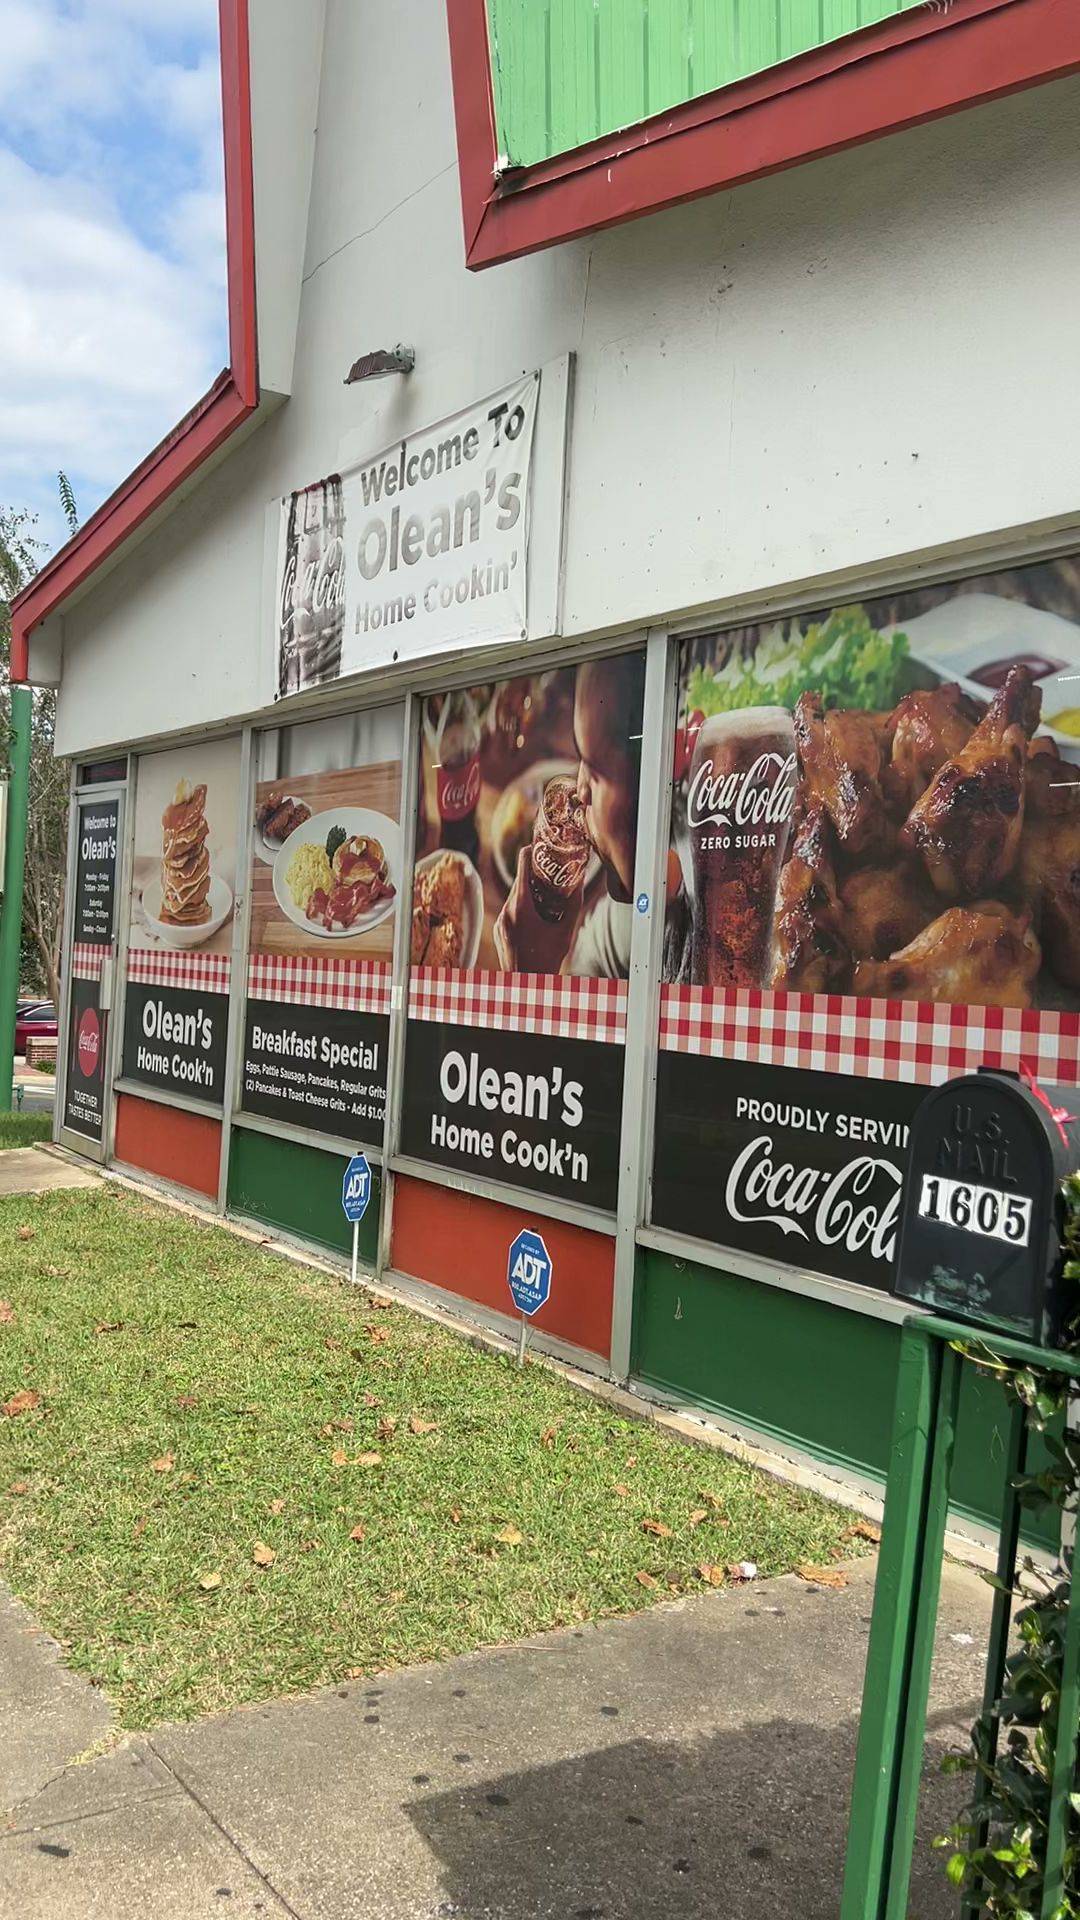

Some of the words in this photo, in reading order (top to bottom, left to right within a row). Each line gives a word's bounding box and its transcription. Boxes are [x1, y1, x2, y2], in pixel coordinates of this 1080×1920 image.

[361, 427, 479, 506] Welcome
[487, 402, 525, 448] To
[357, 467, 522, 580] Olean's
[355, 591, 416, 634] Home
[424, 550, 517, 613] Cookin'
[687, 752, 798, 828] Coca-Cola
[84, 815, 109, 830] Welcome
[109, 814, 116, 828] to
[81, 836, 116, 860] Olean's
[701, 836, 731, 850] ZERO
[735, 834, 776, 848] SUGAR
[142, 1000, 213, 1050] Olean's
[137, 1045, 169, 1075] Home
[172, 1054, 214, 1086] Cook'n
[252, 1026, 318, 1060] Breakfast
[320, 1036, 379, 1071] Special
[246, 1061, 261, 1076] Eggs,
[262, 1064, 279, 1077] Pattie
[280, 1068, 307, 1085] Sausage,
[308, 1073, 339, 1092] Pancakes,
[340, 1079, 367, 1095] Regular
[440, 1050, 584, 1127] Olean's
[68, 1103, 84, 1119] TASTES
[84, 1109, 102, 1126] BETTER
[74, 1089, 97, 1108] TOGETHER
[246, 1080, 255, 1091] (2)
[255, 1081, 282, 1097] Pancakes
[283, 1087, 287, 1098] &
[288, 1088, 305, 1102] Toast
[305, 1092, 328, 1108] Cheese
[330, 1098, 346, 1112] Grits
[351, 1103, 366, 1116] Add
[736, 1096, 830, 1133] PROUDLY
[430, 1113, 494, 1158] Home
[501, 1130, 588, 1182] Cook'n
[345, 1172, 368, 1200] ADT
[924, 1179, 1026, 1242] 1605
[511, 1252, 547, 1290] ADT
